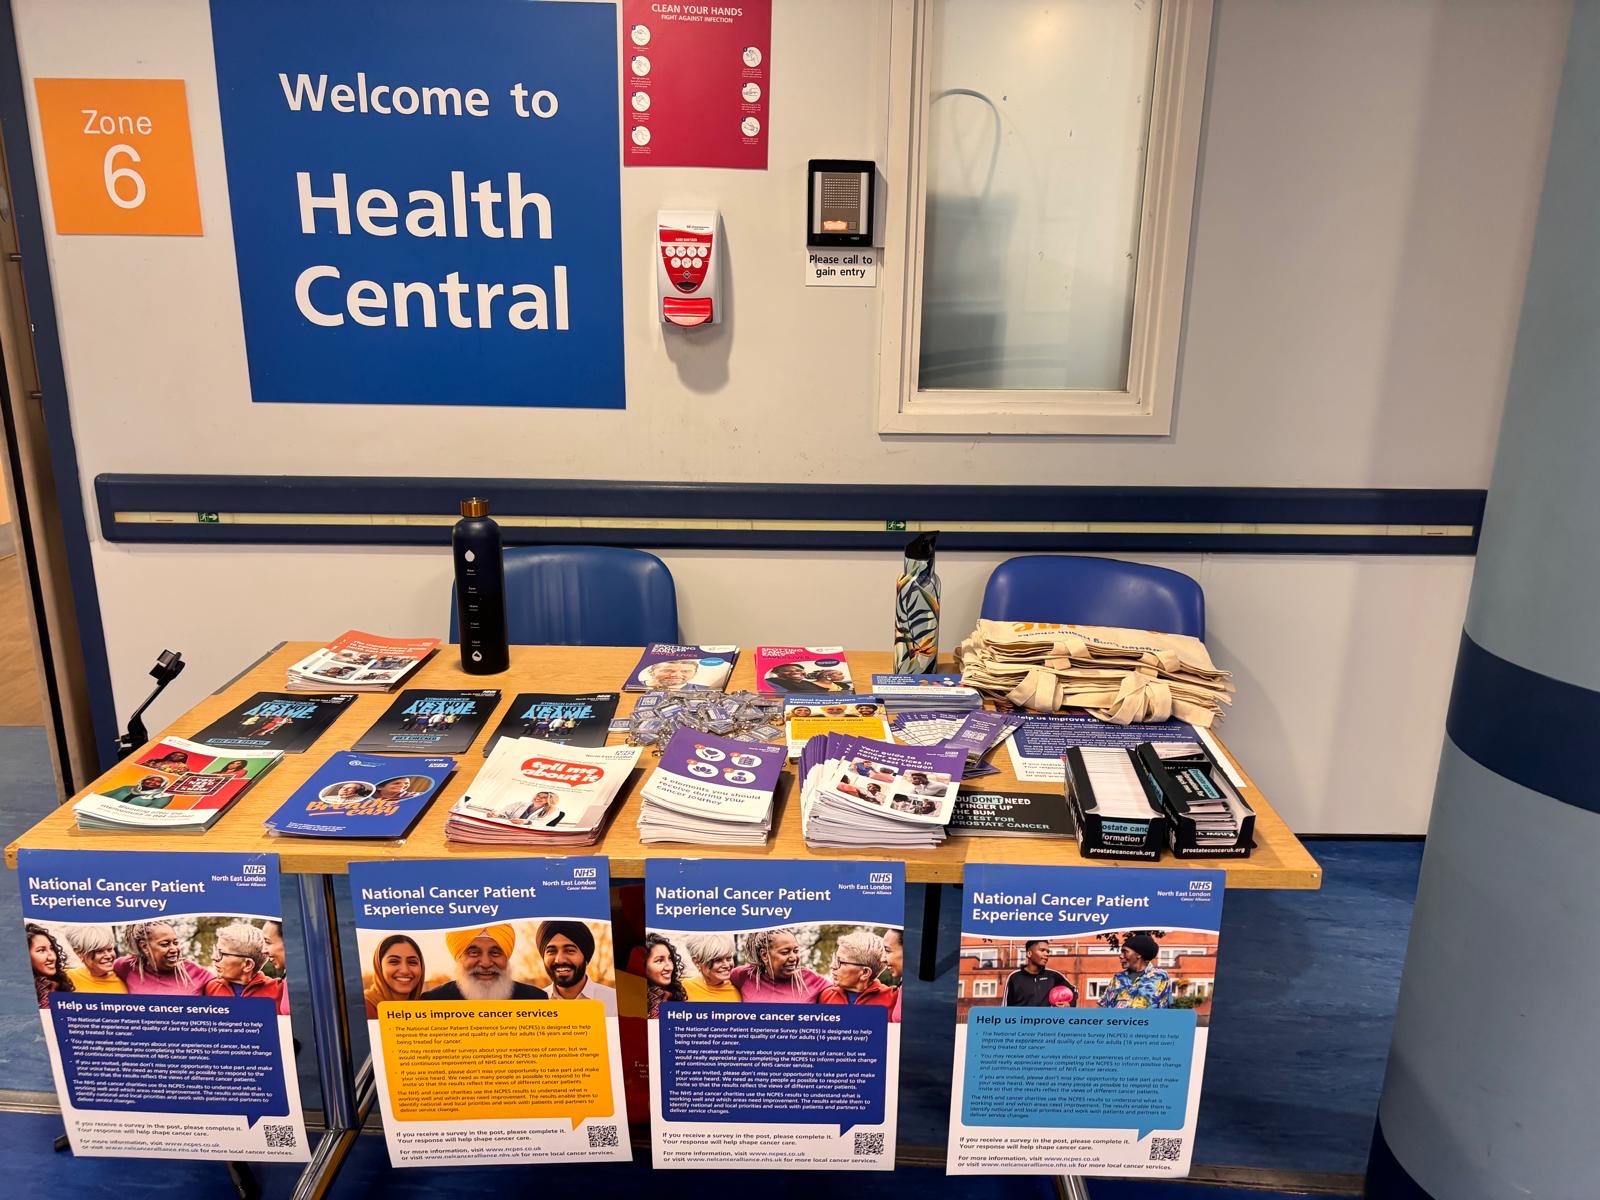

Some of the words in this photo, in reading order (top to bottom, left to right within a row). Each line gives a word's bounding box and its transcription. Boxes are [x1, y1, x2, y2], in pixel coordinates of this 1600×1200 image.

[651, 4, 681, 13] CLEAN
[683, 5, 709, 14] YOUR
[711, 7, 743, 16] HANDS
[278, 73, 489, 118] Welcome
[510, 82, 559, 119] to
[83, 109, 153, 136] Zone
[103, 145, 147, 209] 6
[300, 171, 553, 240] Health
[809, 254, 839, 264] Please
[843, 255, 859, 264] call
[862, 255, 873, 264] to
[816, 267, 836, 278] gain
[840, 268, 866, 278] entry
[294, 265, 570, 331] Central
[858, 749, 883, 759] cancer
[883, 755, 923, 765] services
[860, 745, 880, 754] Your
[881, 750, 906, 759] guide
[856, 751, 879, 762] north
[900, 762, 934, 770] London
[521, 769, 580, 782] about
[585, 773, 600, 783] it
[531, 761, 563, 772] tell
[567, 767, 599, 776] me
[656, 785, 686, 797] cancer
[688, 794, 722, 806] journey
[658, 780, 692, 792] receive
[692, 789, 723, 800] during
[669, 778, 710, 793] elements
[712, 789, 729, 797] you
[730, 791, 761, 800] should
[1090, 847, 1155, 857] prostatecanceruk.org
[244, 865, 266, 874] NHS
[574, 868, 596, 878] NHS
[28, 876, 92, 892] National
[96, 878, 147, 893] Cancer
[151, 879, 206, 894] Patient
[870, 873, 892, 883] NHS
[361, 886, 425, 900] National
[429, 886, 479, 899] Cancer
[484, 886, 536, 898] Patient
[655, 886, 719, 900] National
[723, 887, 773, 900] Cancer
[778, 888, 831, 901] Patient
[1190, 881, 1212, 891] NHS
[31, 894, 111, 909] Experience
[116, 896, 167, 911] Survey
[973, 893, 1036, 905] National
[1041, 894, 1092, 906] Cancer
[1096, 894, 1150, 908] Patient
[364, 903, 444, 917] Experience
[448, 902, 499, 917] Survey
[655, 903, 737, 918] Experience
[741, 903, 792, 919] Survey
[972, 909, 1053, 923] Experience
[1058, 910, 1109, 925] Survey
[57, 1001, 84, 1012] Help
[86, 1003, 98, 1011] us
[101, 1002, 146, 1014] improve
[148, 1005, 183, 1013] cancer
[186, 1005, 230, 1014] services
[387, 1009, 412, 1021] Help
[415, 1011, 427, 1019] us
[430, 1009, 475, 1020] improve
[478, 1010, 513, 1018] cancer
[516, 1008, 558, 1018] services
[668, 1010, 693, 1023] Help
[696, 1012, 708, 1020] us
[711, 1011, 756, 1023] improve
[759, 1013, 794, 1021] cancer
[798, 1012, 841, 1022] services
[976, 1015, 1002, 1027] Help
[1004, 1017, 1017, 1025] us
[1020, 1016, 1065, 1028] improve
[1068, 1018, 1104, 1026] cancer
[1106, 1017, 1149, 1027] services
